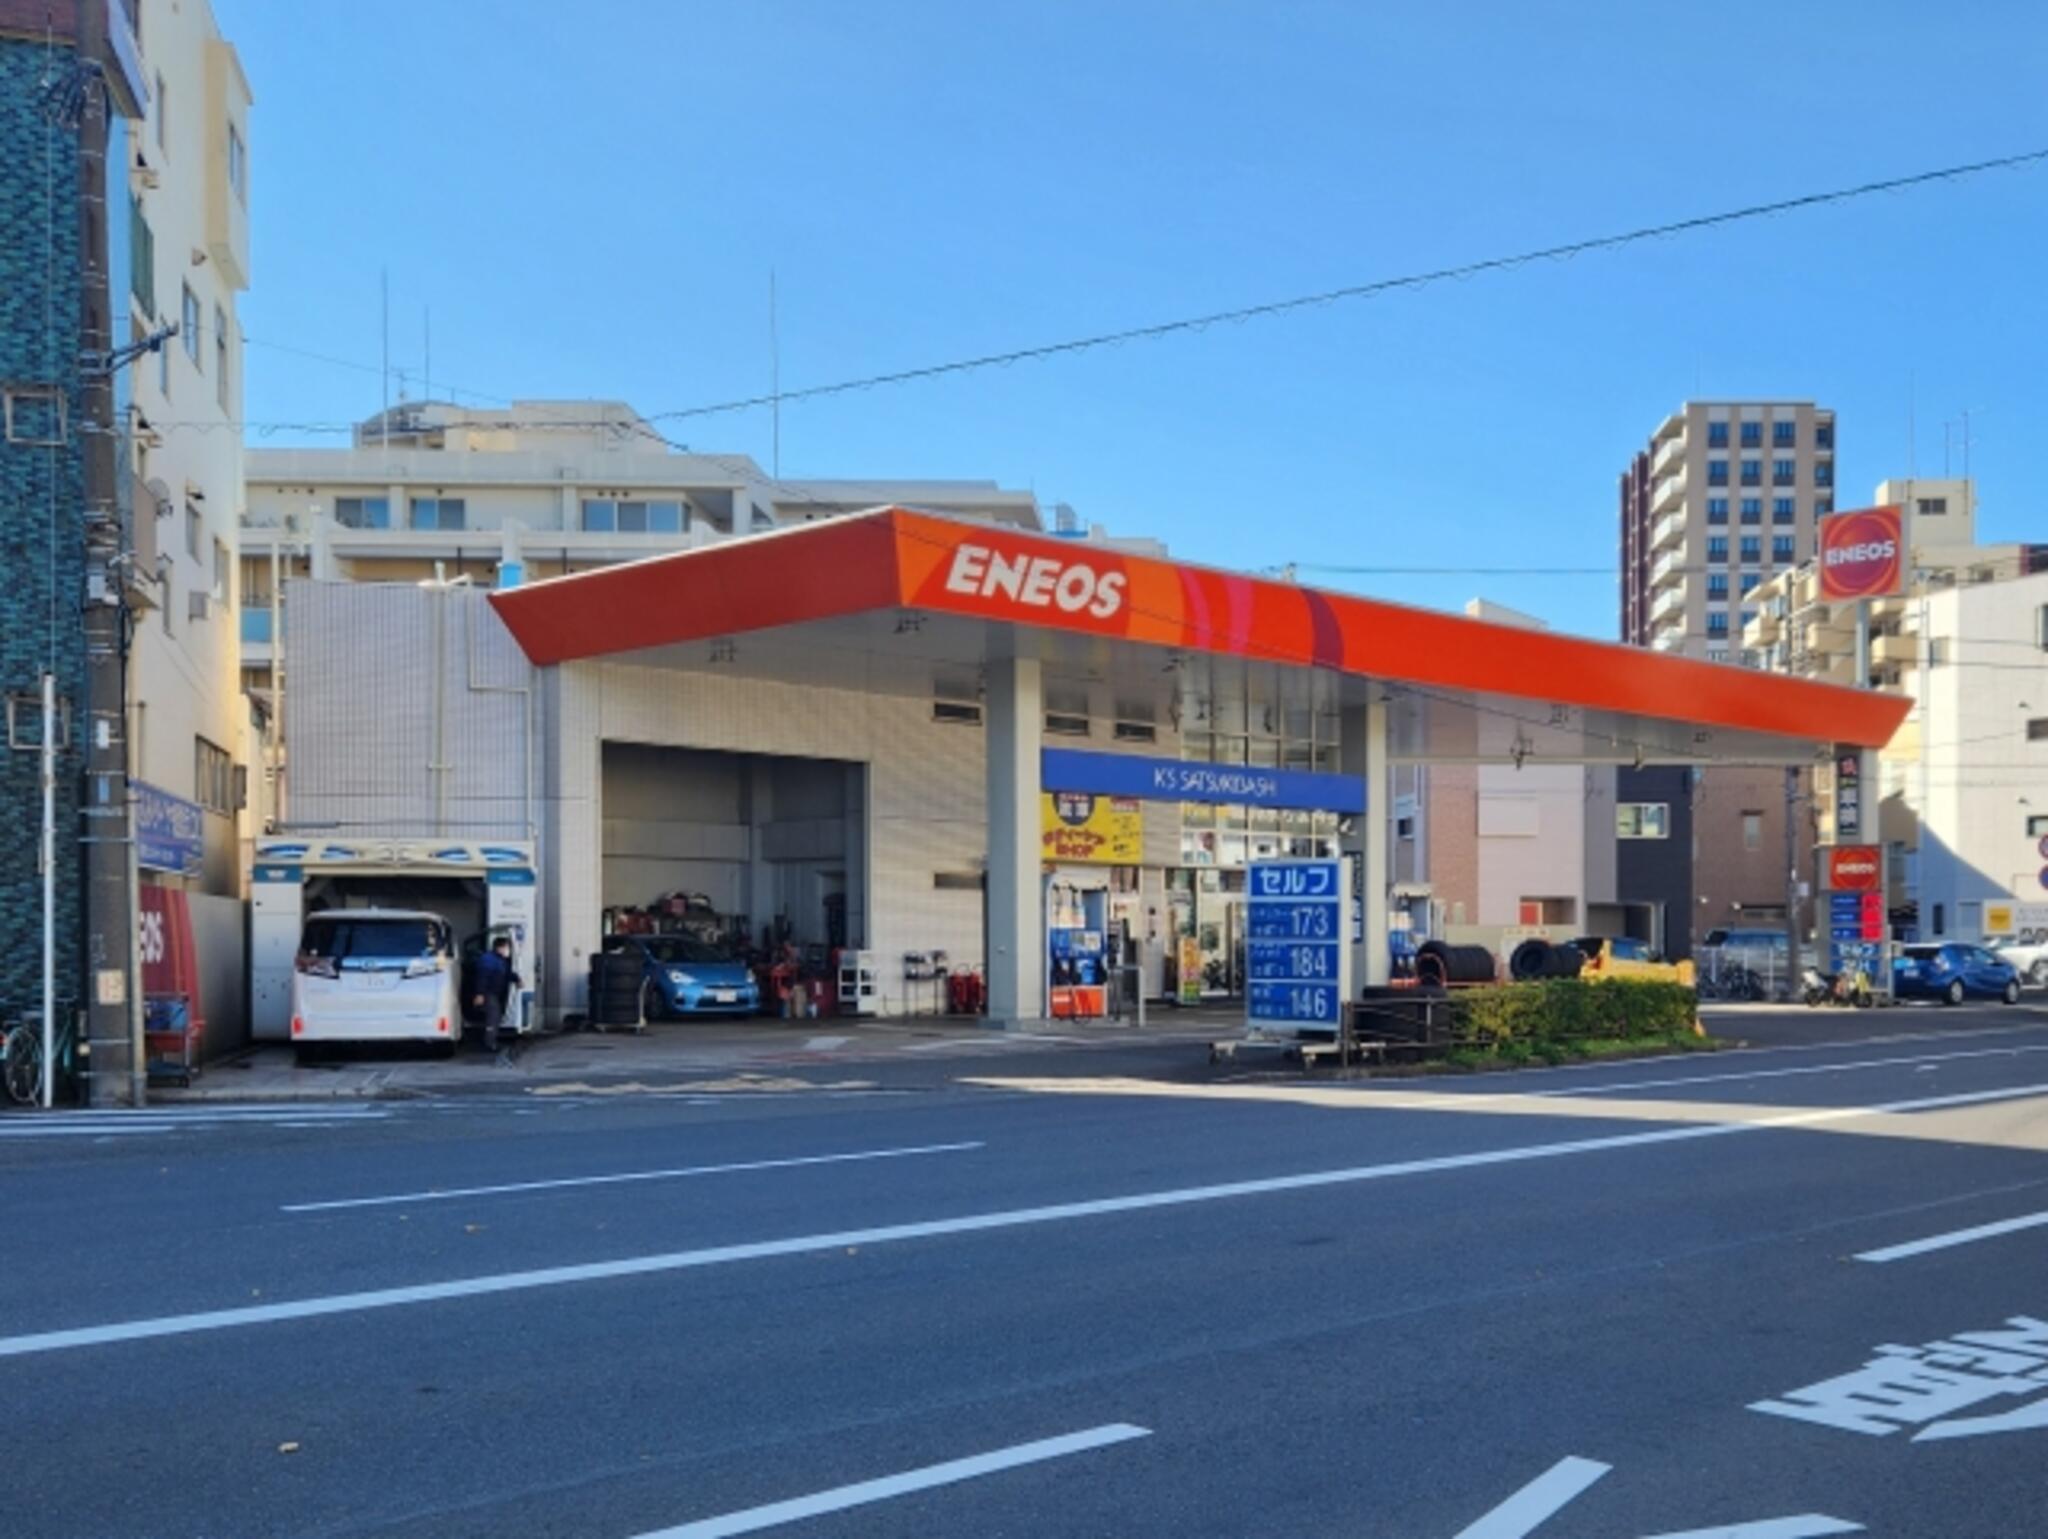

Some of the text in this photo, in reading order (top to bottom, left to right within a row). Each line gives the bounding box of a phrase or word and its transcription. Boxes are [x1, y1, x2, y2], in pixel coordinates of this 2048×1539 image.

[1825, 540, 1896, 567] ENEOS
[946, 543, 1127, 619] ENEOS
[1260, 866, 1329, 894] セルフ
[1290, 905, 1329, 937] 173
[1290, 946, 1328, 977] 184
[1290, 987, 1328, 1019] 146
